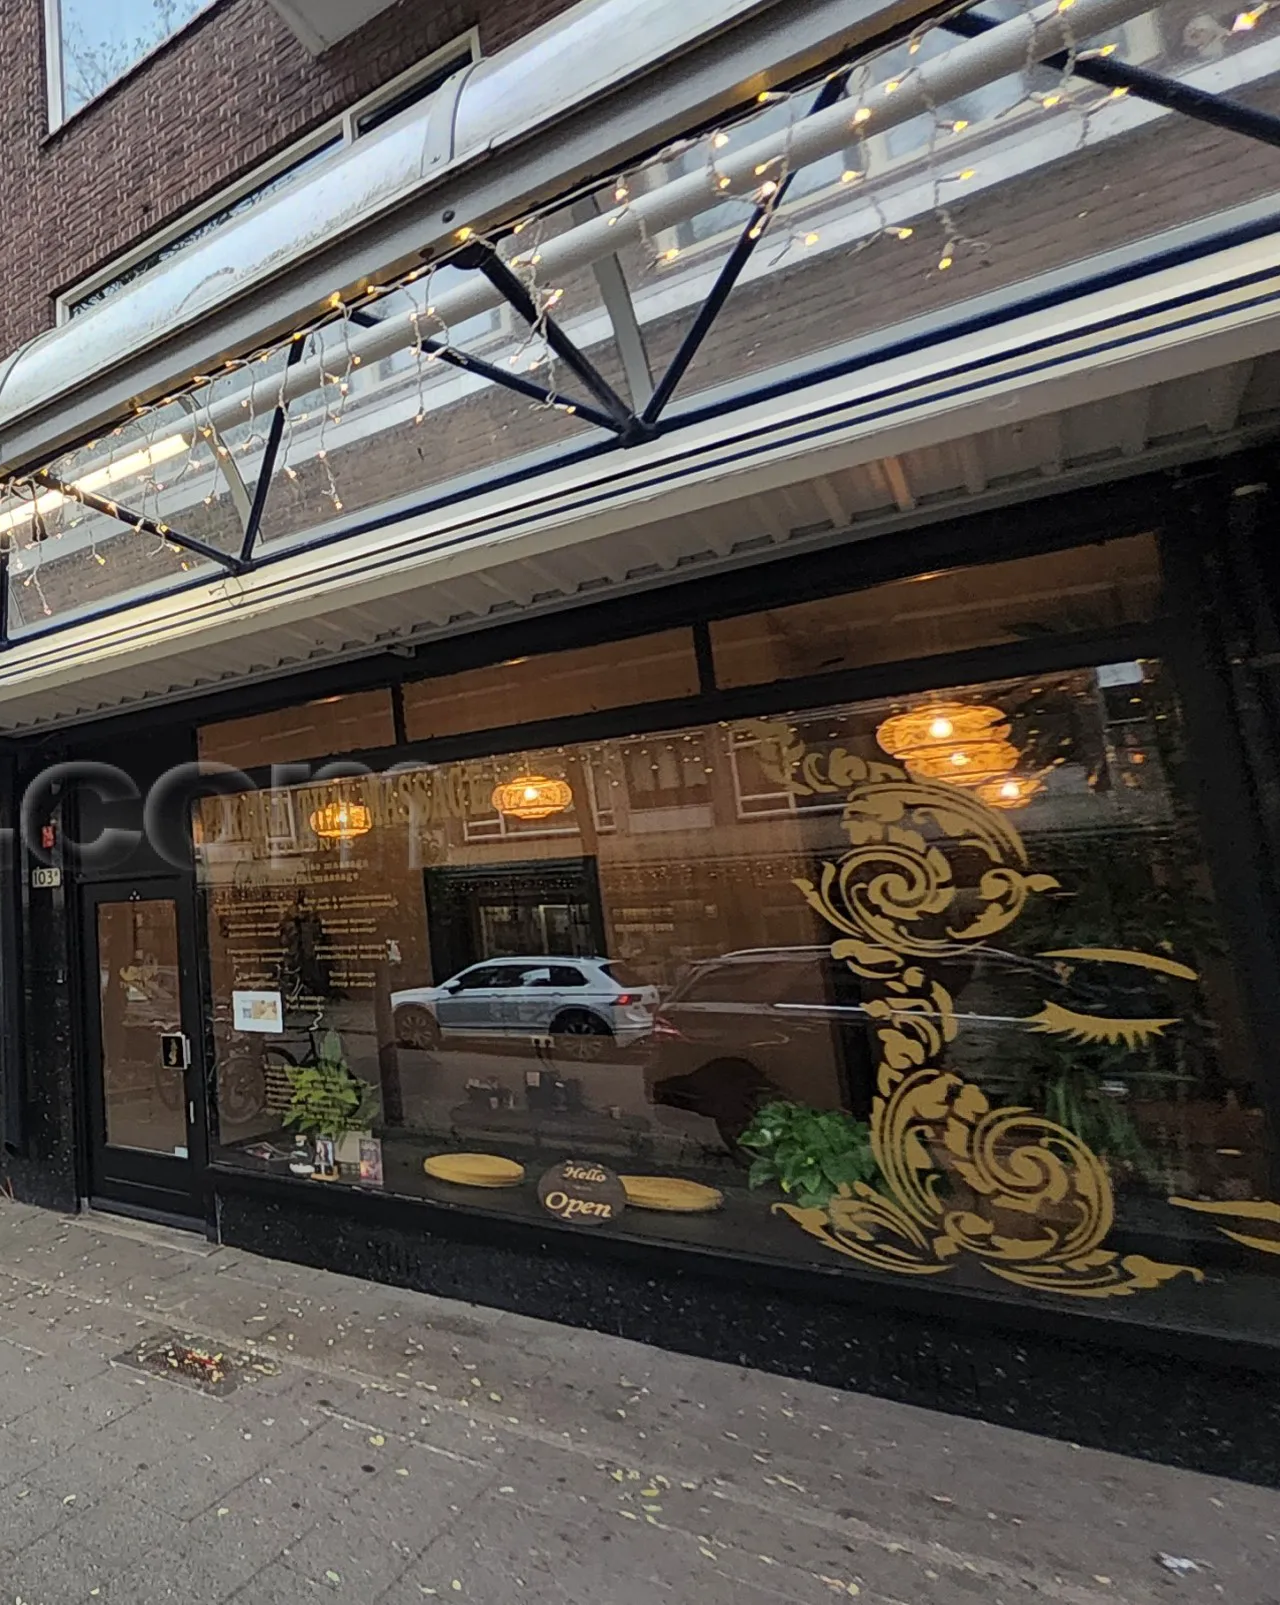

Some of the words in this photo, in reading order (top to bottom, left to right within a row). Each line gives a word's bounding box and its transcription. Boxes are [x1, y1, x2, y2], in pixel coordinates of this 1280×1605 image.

[362, 762, 495, 827] MASSAGE
[562, 1165, 607, 1182] Hello
[545, 1191, 612, 1219] Open
